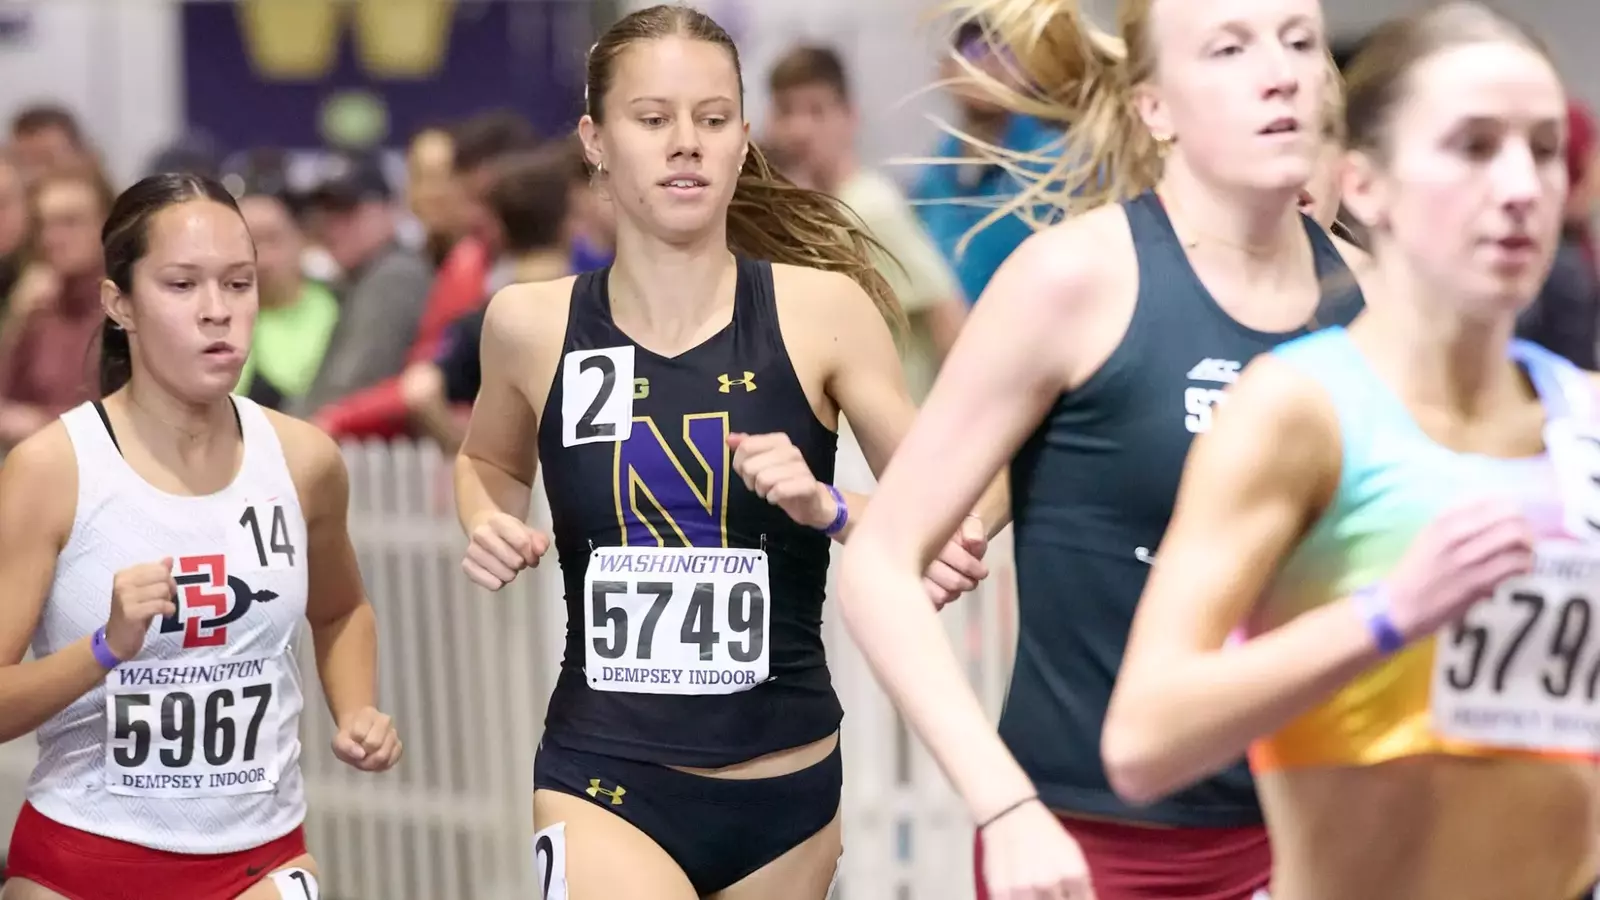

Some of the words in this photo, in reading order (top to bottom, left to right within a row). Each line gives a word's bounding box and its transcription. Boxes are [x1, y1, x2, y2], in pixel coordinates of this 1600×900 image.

[575, 354, 617, 440] 2
[613, 411, 731, 549] N
[238, 504, 296, 567] 14
[599, 554, 757, 575] WASHINGTON
[591, 580, 765, 663] 5749
[118, 657, 265, 686] WASHINGTON
[602, 666, 684, 684] DEMPSEY
[689, 669, 757, 685] INDOOR
[112, 683, 274, 769] 5967
[121, 772, 205, 790] DEMPSEY
[209, 767, 267, 788] INDOOR
